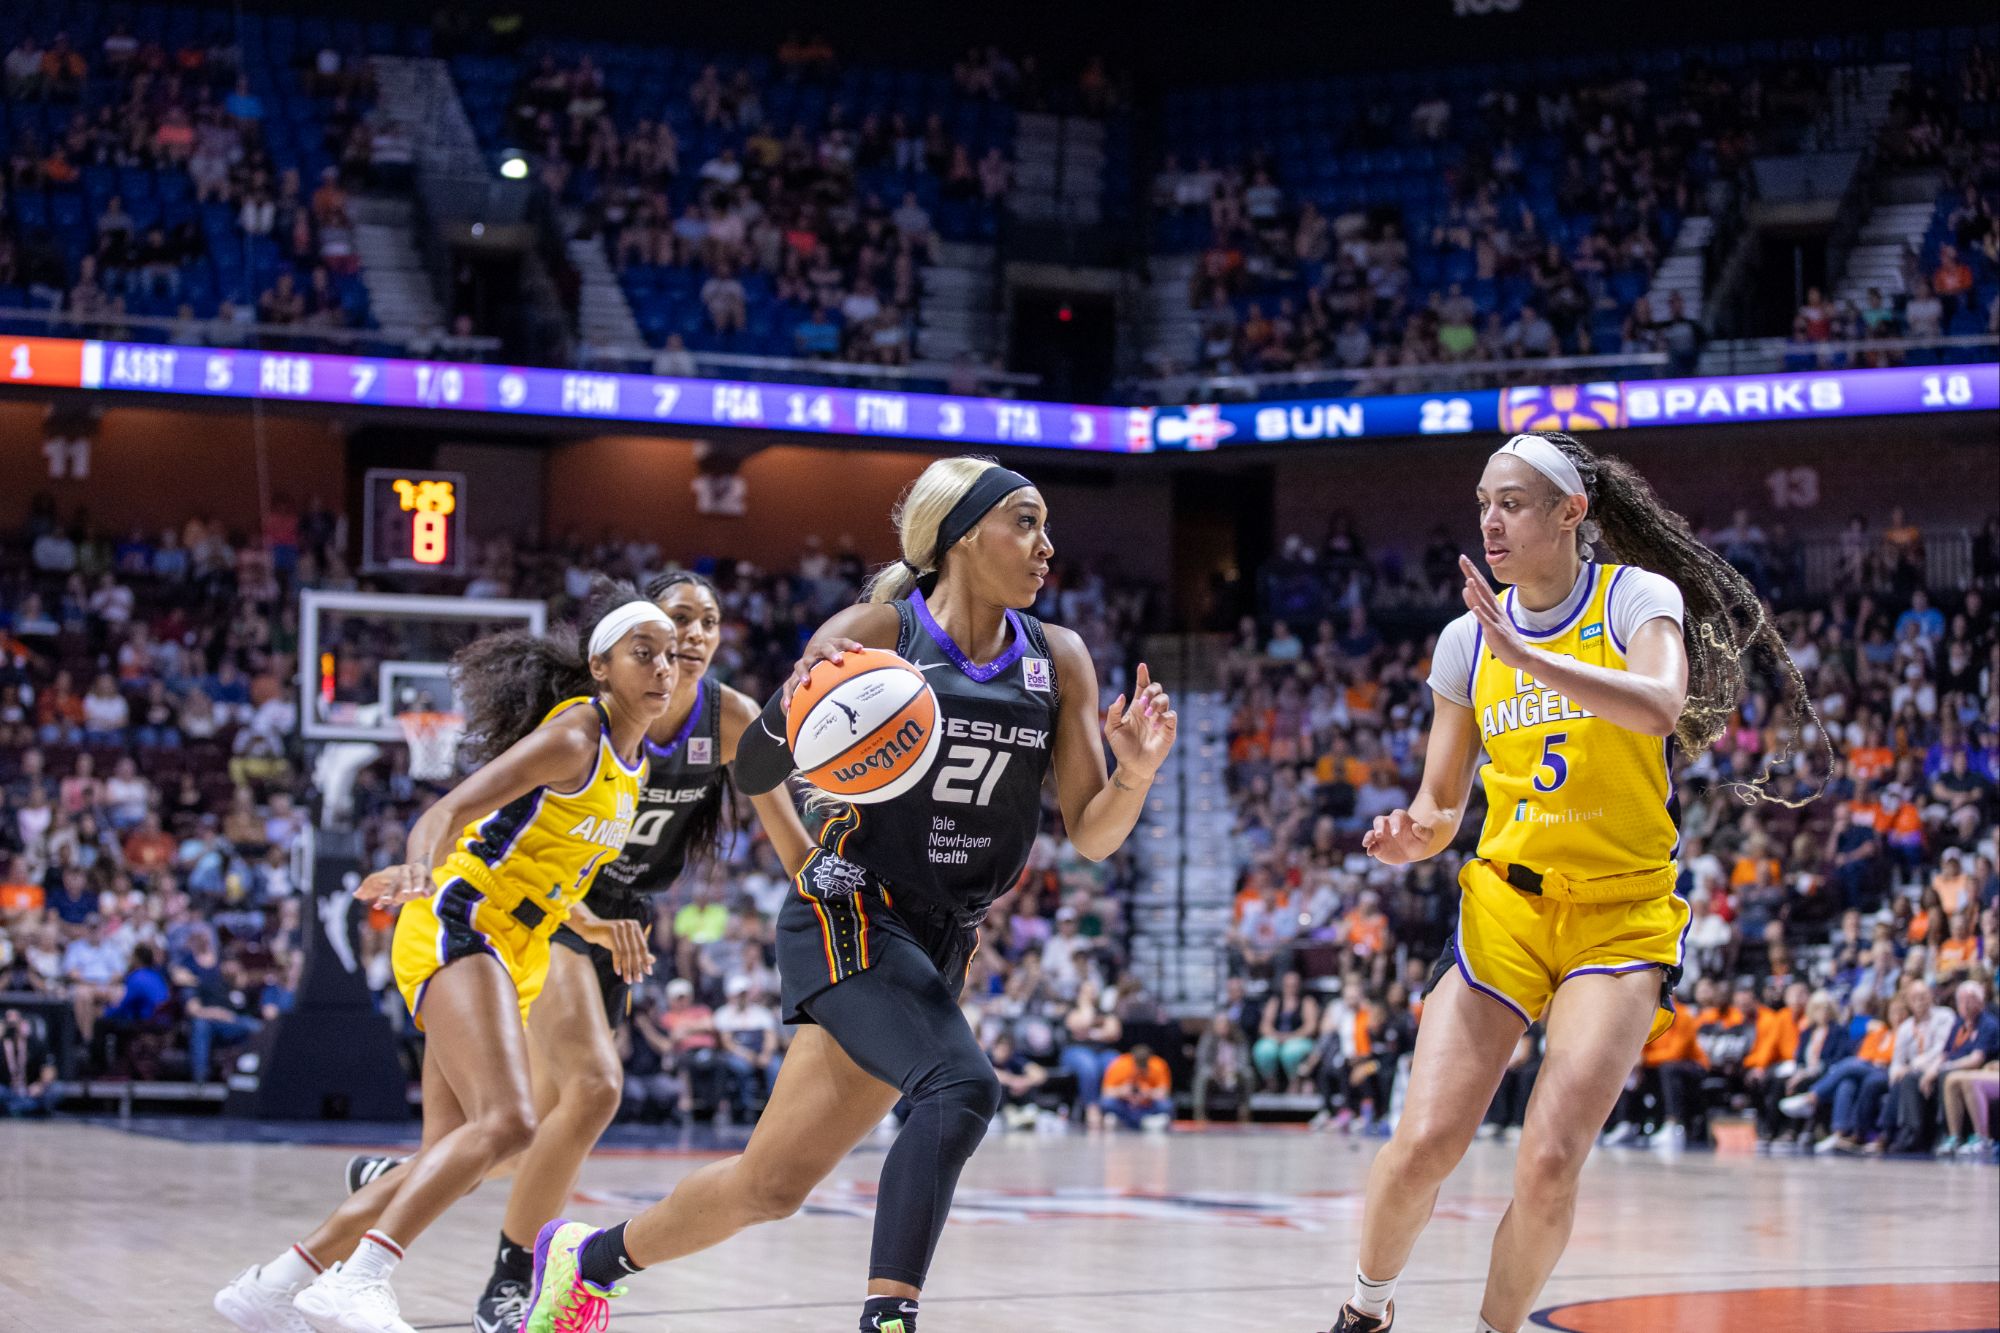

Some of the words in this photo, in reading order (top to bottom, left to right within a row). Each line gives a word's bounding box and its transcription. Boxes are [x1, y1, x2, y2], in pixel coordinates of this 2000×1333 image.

[10, 344, 34, 379] 1
[108, 347, 177, 388] ASST
[204, 355, 233, 391] 5
[259, 356, 313, 395] REB
[350, 364, 378, 399] 7
[498, 372, 527, 408] 9
[652, 383, 681, 418] 7
[712, 383, 764, 422] FGA
[786, 391, 834, 429] 14
[1626, 377, 1844, 420] SPARKS
[1921, 373, 1973, 408] 18
[937, 402, 966, 437] 3
[1069, 411, 1094, 444] 3
[1254, 403, 1364, 442] SUN
[1418, 398, 1473, 435] 22
[42, 437, 91, 479] 11
[691, 474, 746, 516] 12
[412, 510, 447, 564] 8
[1583, 625, 1602, 638] UCLA
[1027, 673, 1048, 685] Post
[1482, 688, 1598, 743] ANGEL
[832, 718, 926, 783] Wilson
[1532, 731, 1569, 793] 5
[931, 744, 1013, 807] 21
[932, 815, 956, 831] Yale
[1528, 806, 1604, 828] EquiTrust
[927, 848, 969, 864] Health
[928, 831, 992, 848] NewHaven
